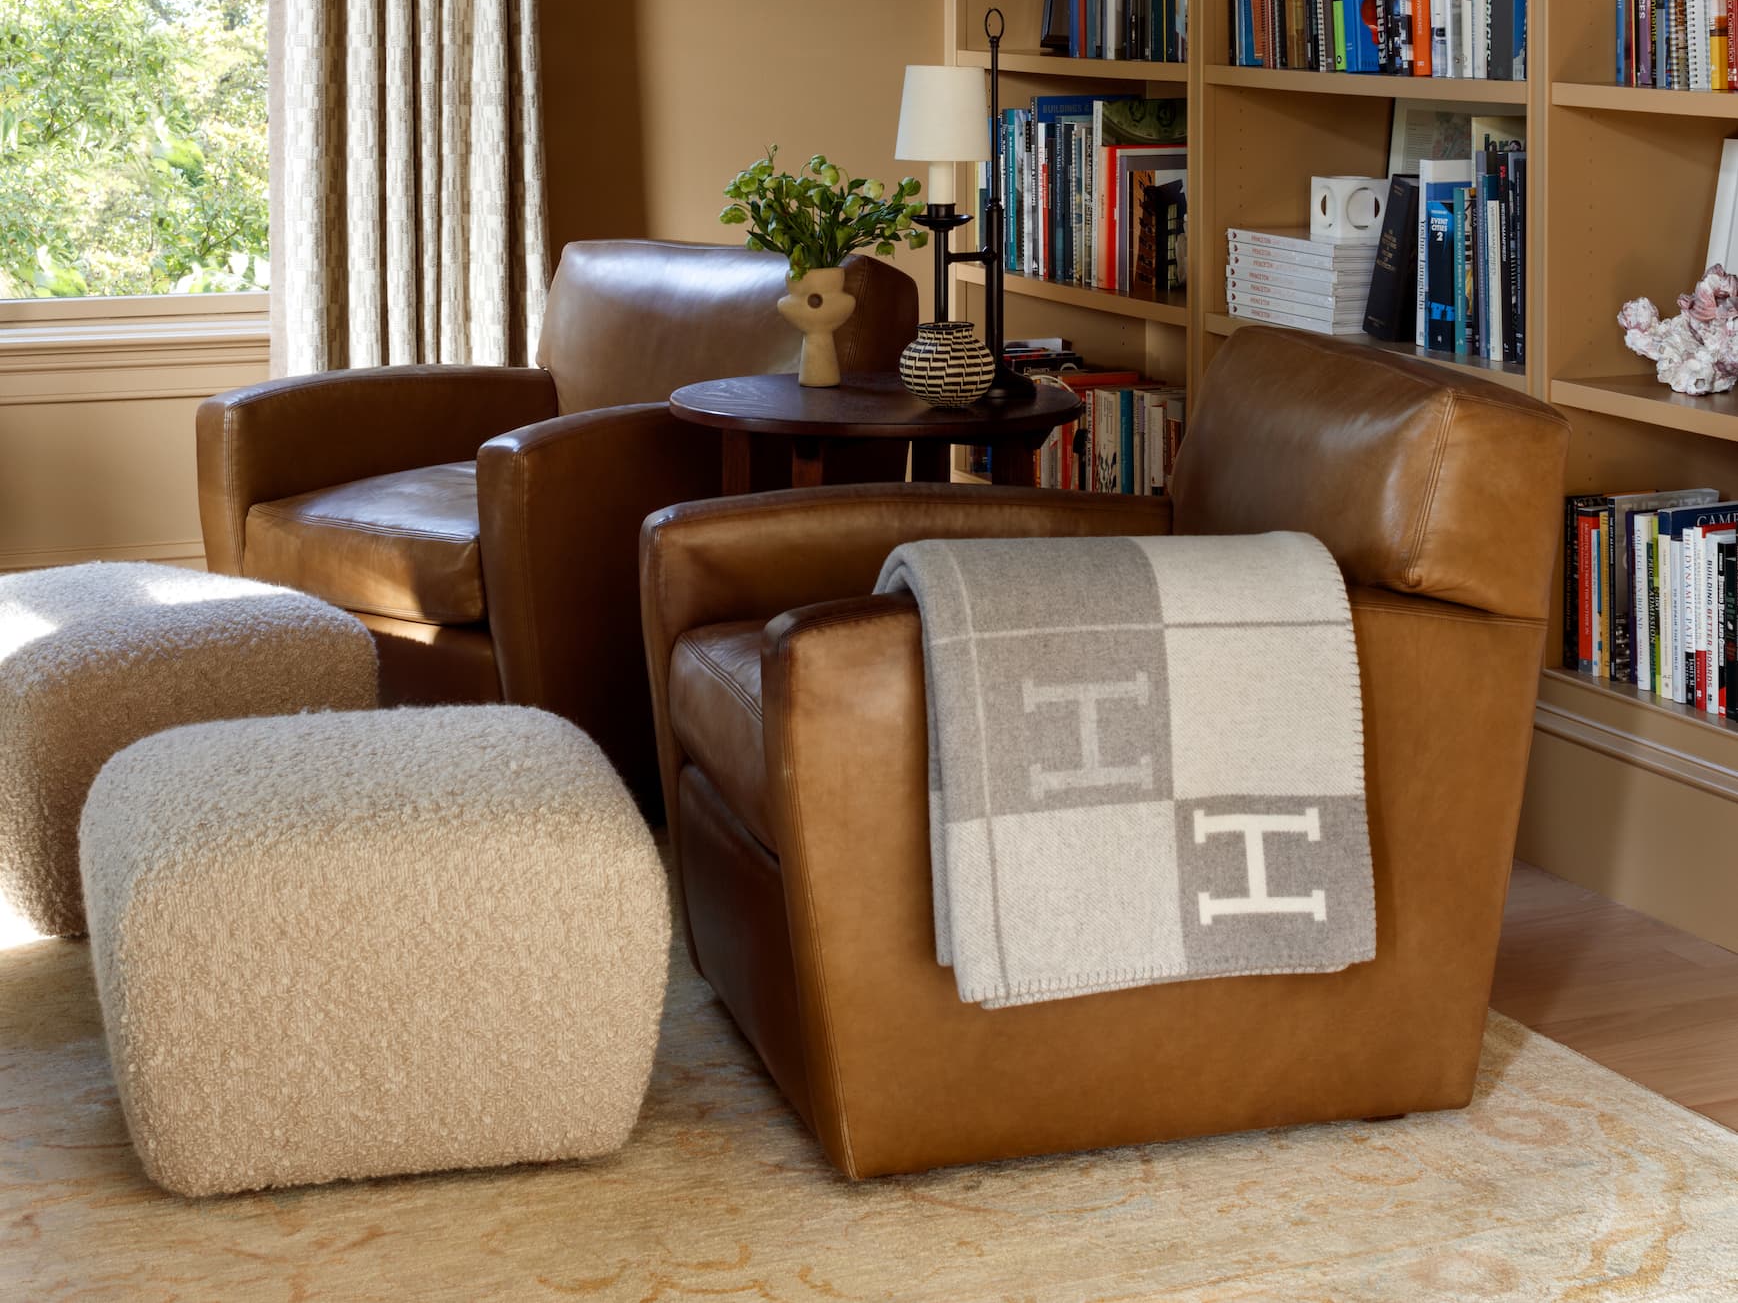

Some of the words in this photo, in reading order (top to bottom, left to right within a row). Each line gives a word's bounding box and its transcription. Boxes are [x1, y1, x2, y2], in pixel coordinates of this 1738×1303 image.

[1436, 232, 1443, 241] 2
[1684, 555, 1692, 613] DYNAMIC
[1022, 671, 1153, 798] H
[1194, 807, 1327, 925] H
